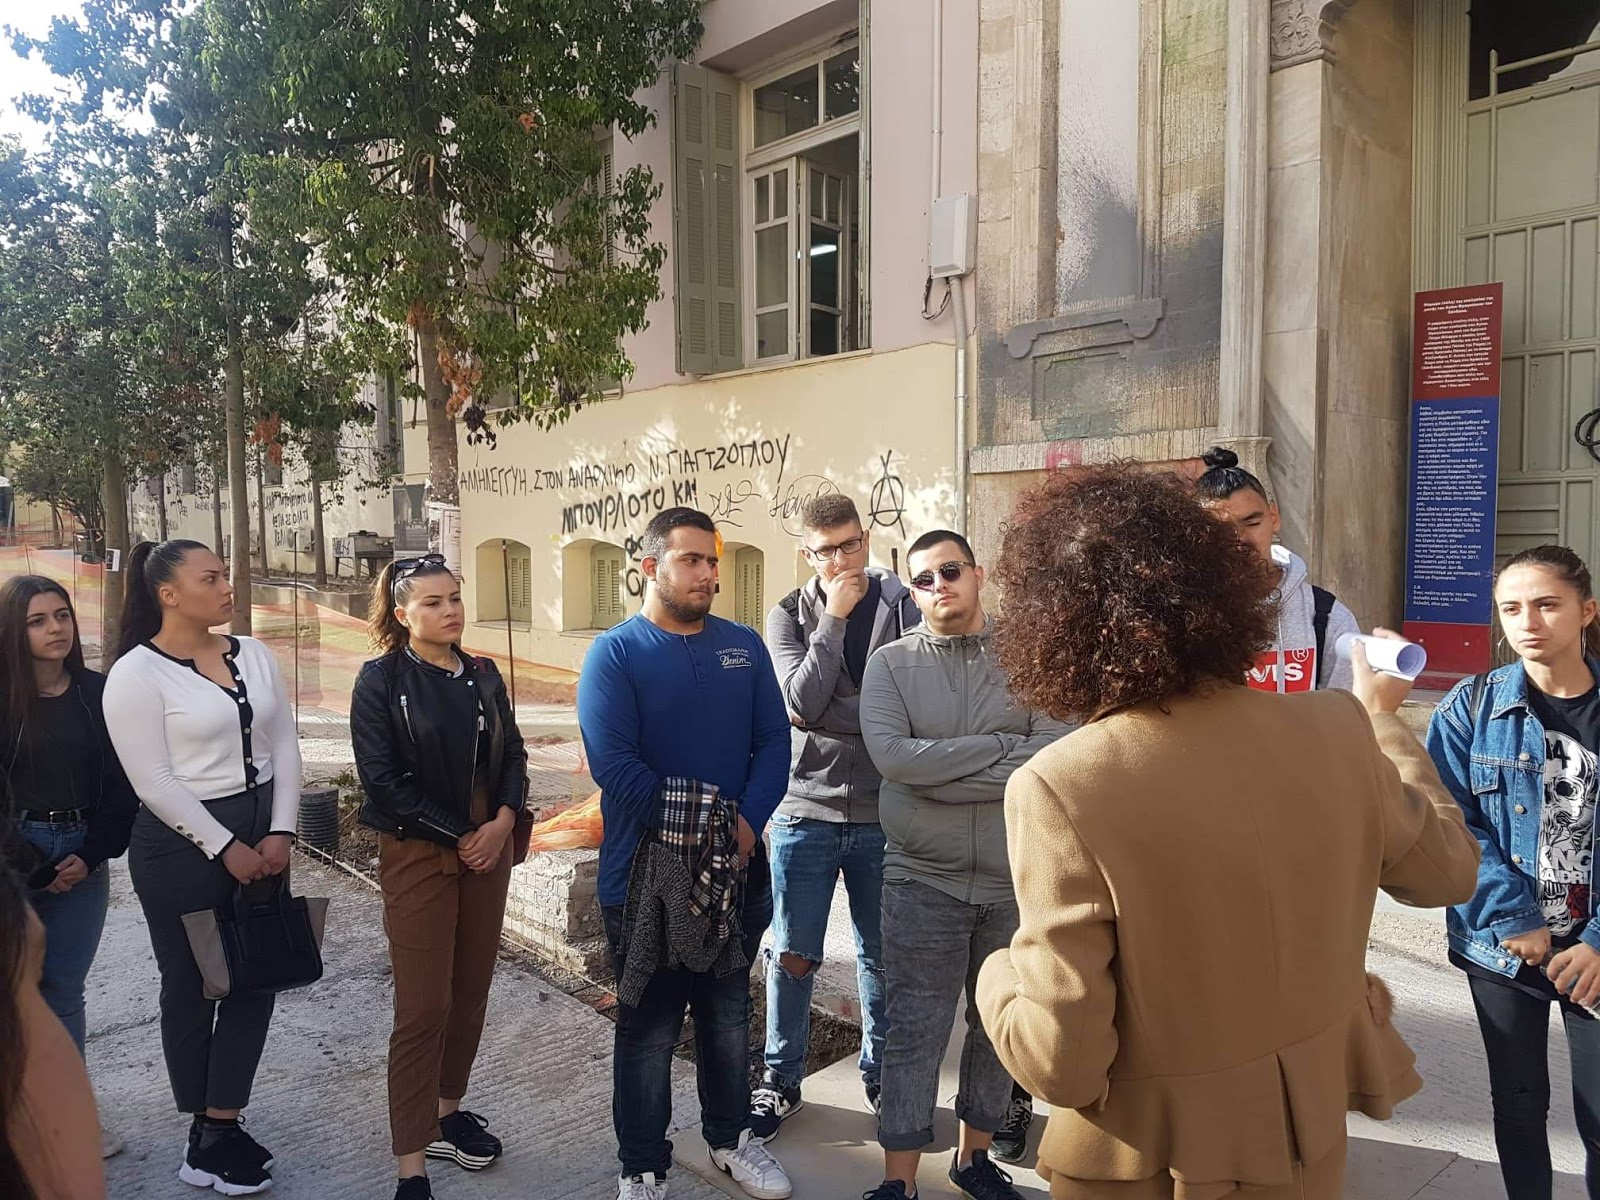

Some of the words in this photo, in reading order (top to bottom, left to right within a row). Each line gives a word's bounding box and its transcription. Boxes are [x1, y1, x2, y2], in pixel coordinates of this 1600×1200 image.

[533, 469, 563, 491] ΣΤΟΝ
[561, 485, 666, 535] ΜΠΟΥΡΛΟΤΟ
[720, 655, 752, 666] Denim
